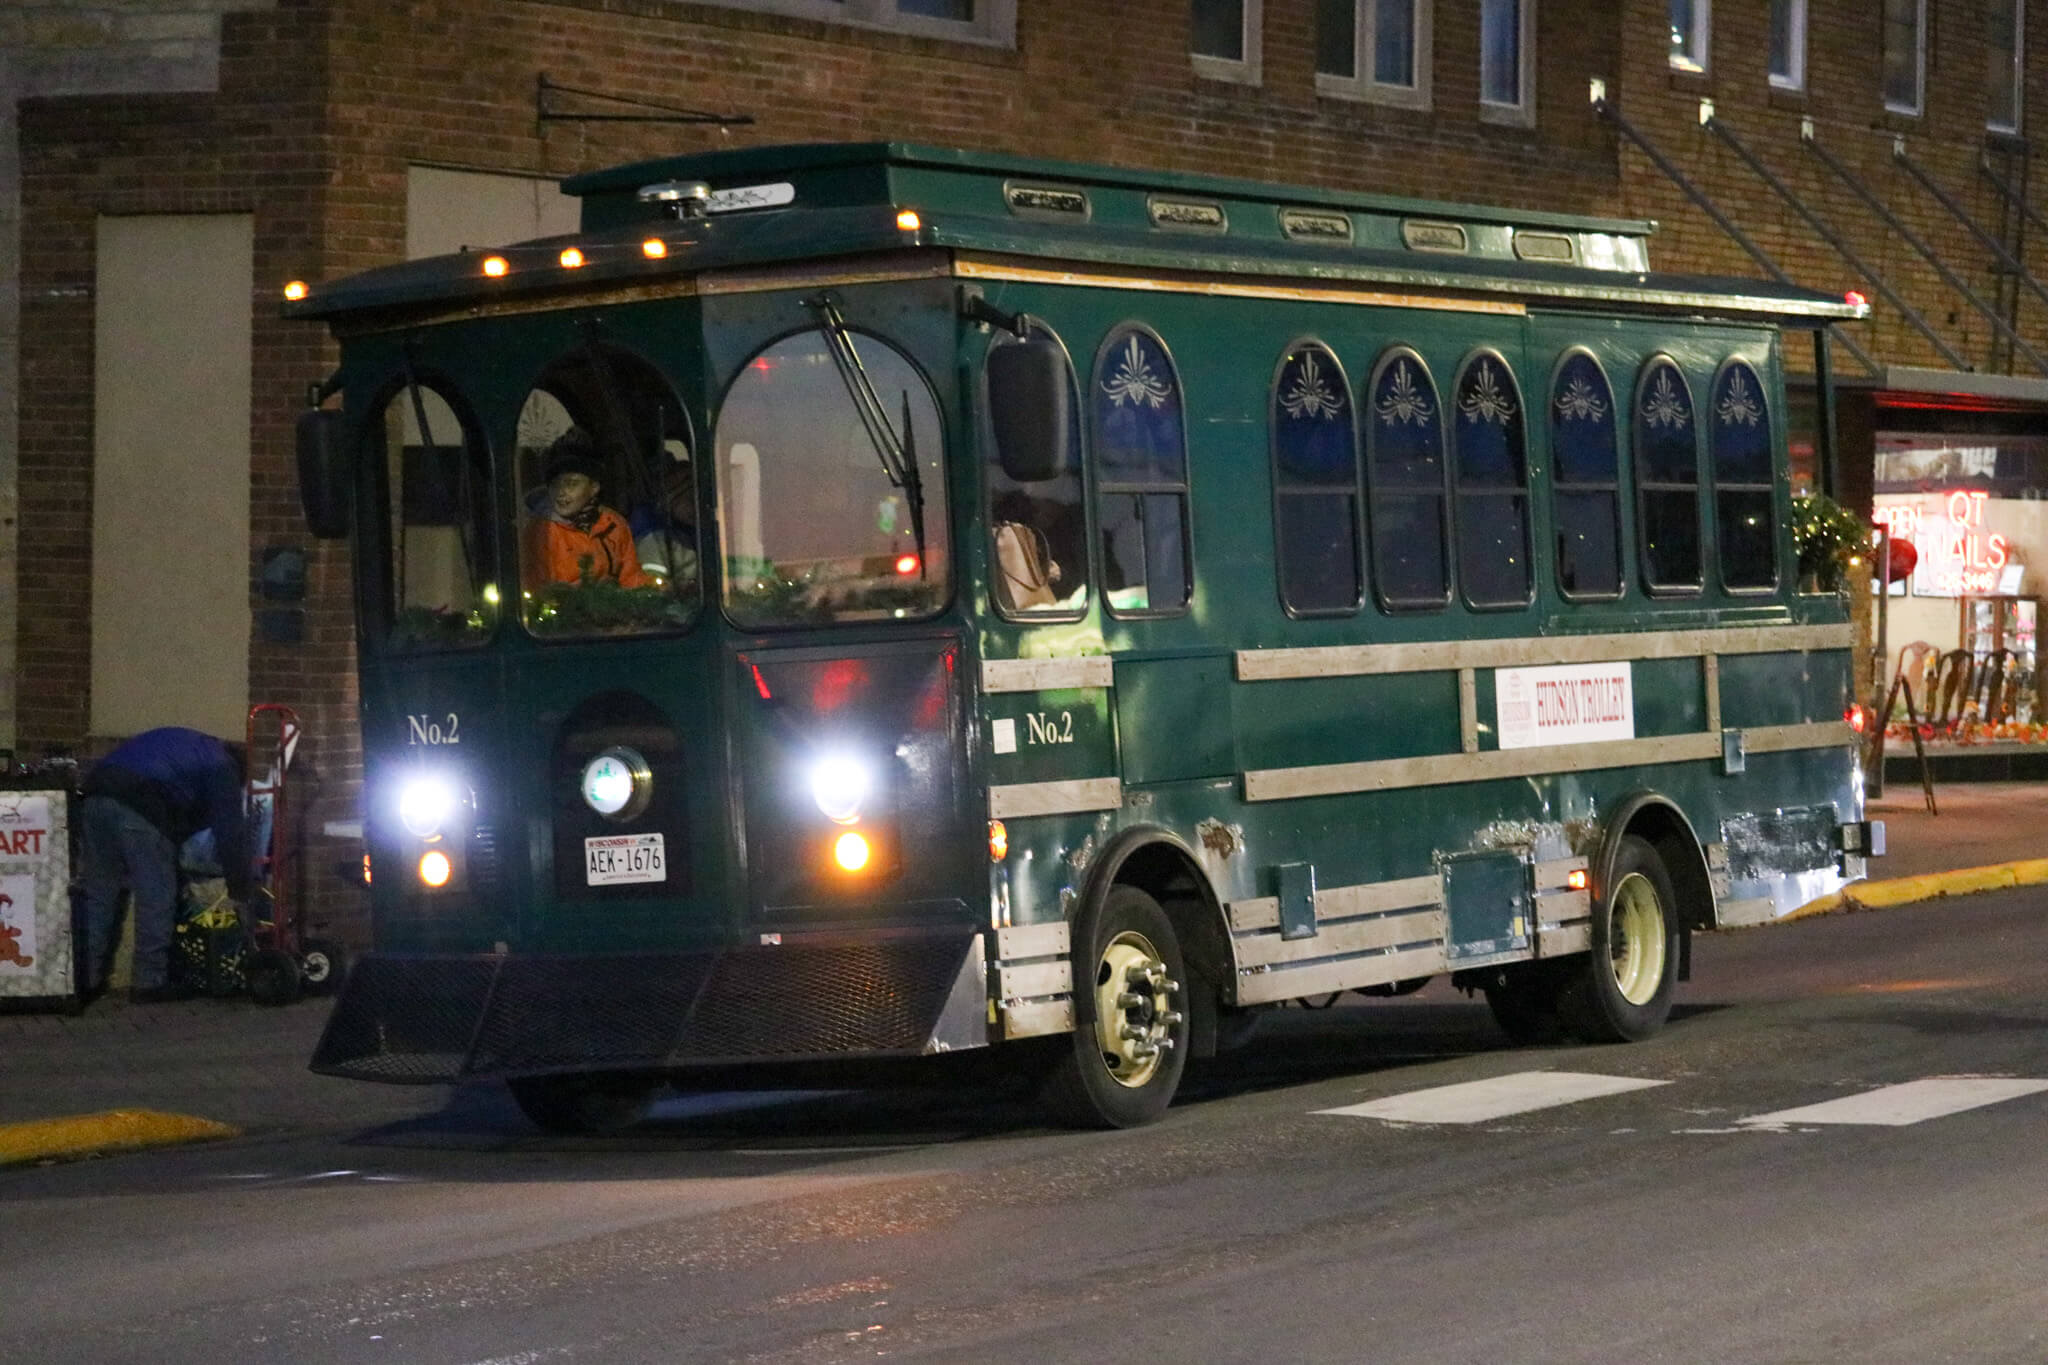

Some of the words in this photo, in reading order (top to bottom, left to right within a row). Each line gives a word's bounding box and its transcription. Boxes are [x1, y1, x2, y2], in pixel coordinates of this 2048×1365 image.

[1875, 505, 1922, 534] OPEN
[1949, 491, 1988, 529] QT
[1927, 533, 2006, 569] NAILS
[1536, 680, 1580, 727] HUDSON
[1580, 676, 1625, 724] TROLLEY
[407, 713, 460, 745] No.2
[1026, 711, 1074, 744] No.2
[590, 847, 662, 874] AEK-1676
